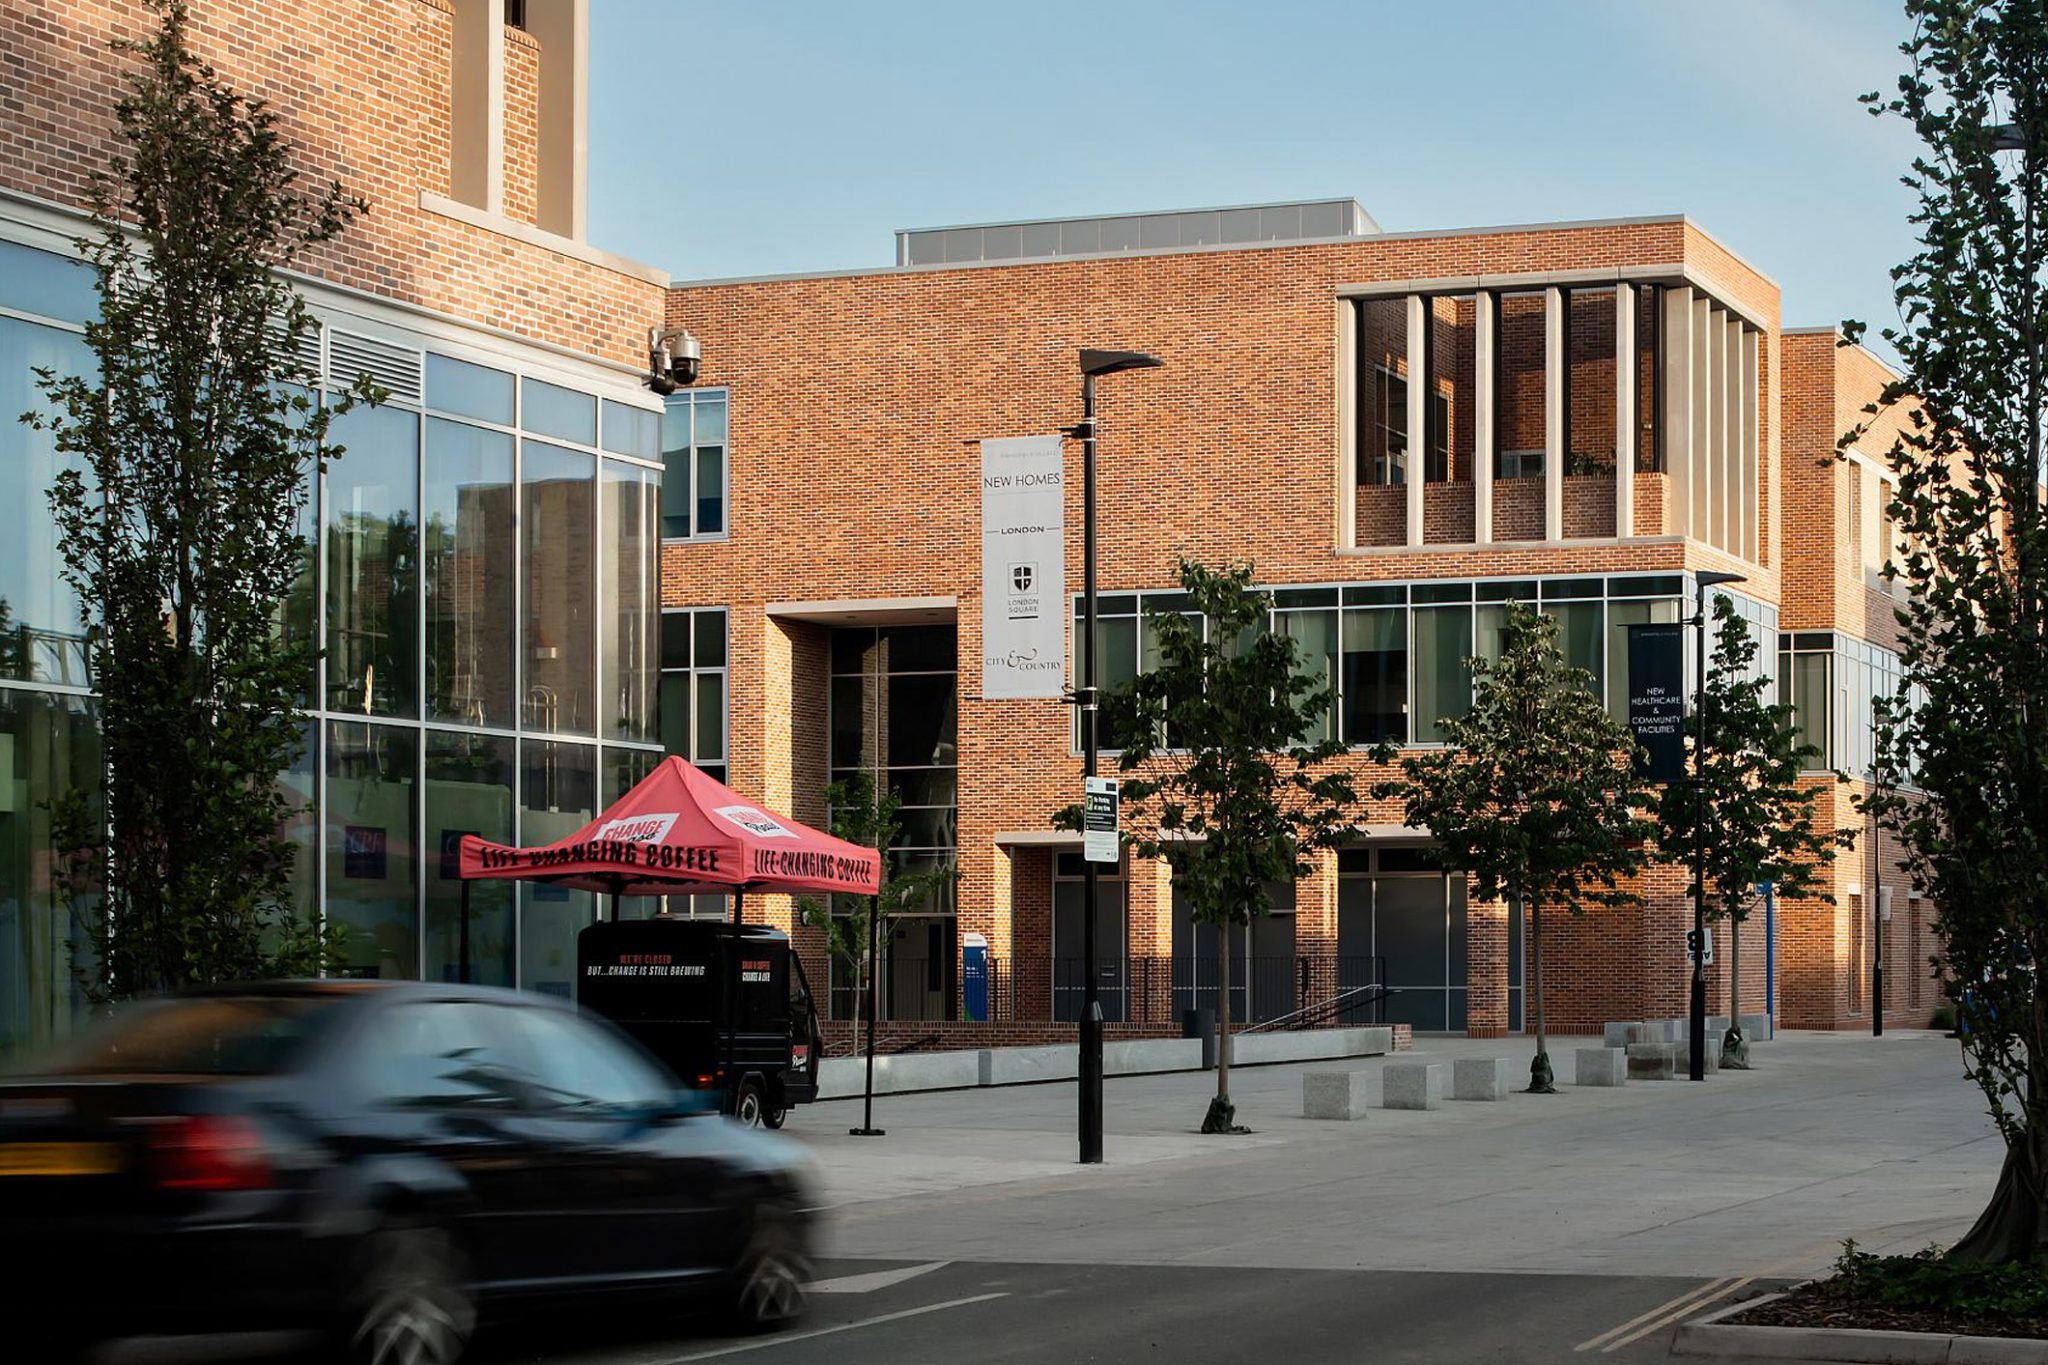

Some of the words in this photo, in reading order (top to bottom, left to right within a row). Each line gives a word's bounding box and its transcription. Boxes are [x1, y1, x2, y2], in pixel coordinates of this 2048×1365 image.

[984, 476, 1012, 488] NEW
[1016, 473, 1060, 487] HOMES
[1001, 526, 1045, 535] LONDON
[1008, 598, 1039, 606] LONDON
[985, 658, 1005, 666] CITY
[1007, 648, 1037, 668] &
[1019, 662, 1061, 671] COUNTRY
[1646, 687, 1665, 695] NEW
[1631, 696, 1681, 705] HEALTHCARE
[1631, 716, 1681, 725] COMMUNITY
[1638, 725, 1675, 734] FACILITIES
[603, 819, 666, 841] CHANGE
[645, 844, 720, 872] COFFEE
[754, 849, 834, 879] LIFE-CHANGING
[836, 856, 871, 884] COFFEE
[645, 954, 672, 964] CLOSED
[638, 965, 647, 976] IS
[649, 965, 669, 976] STILL
[670, 965, 706, 976] BREWING
